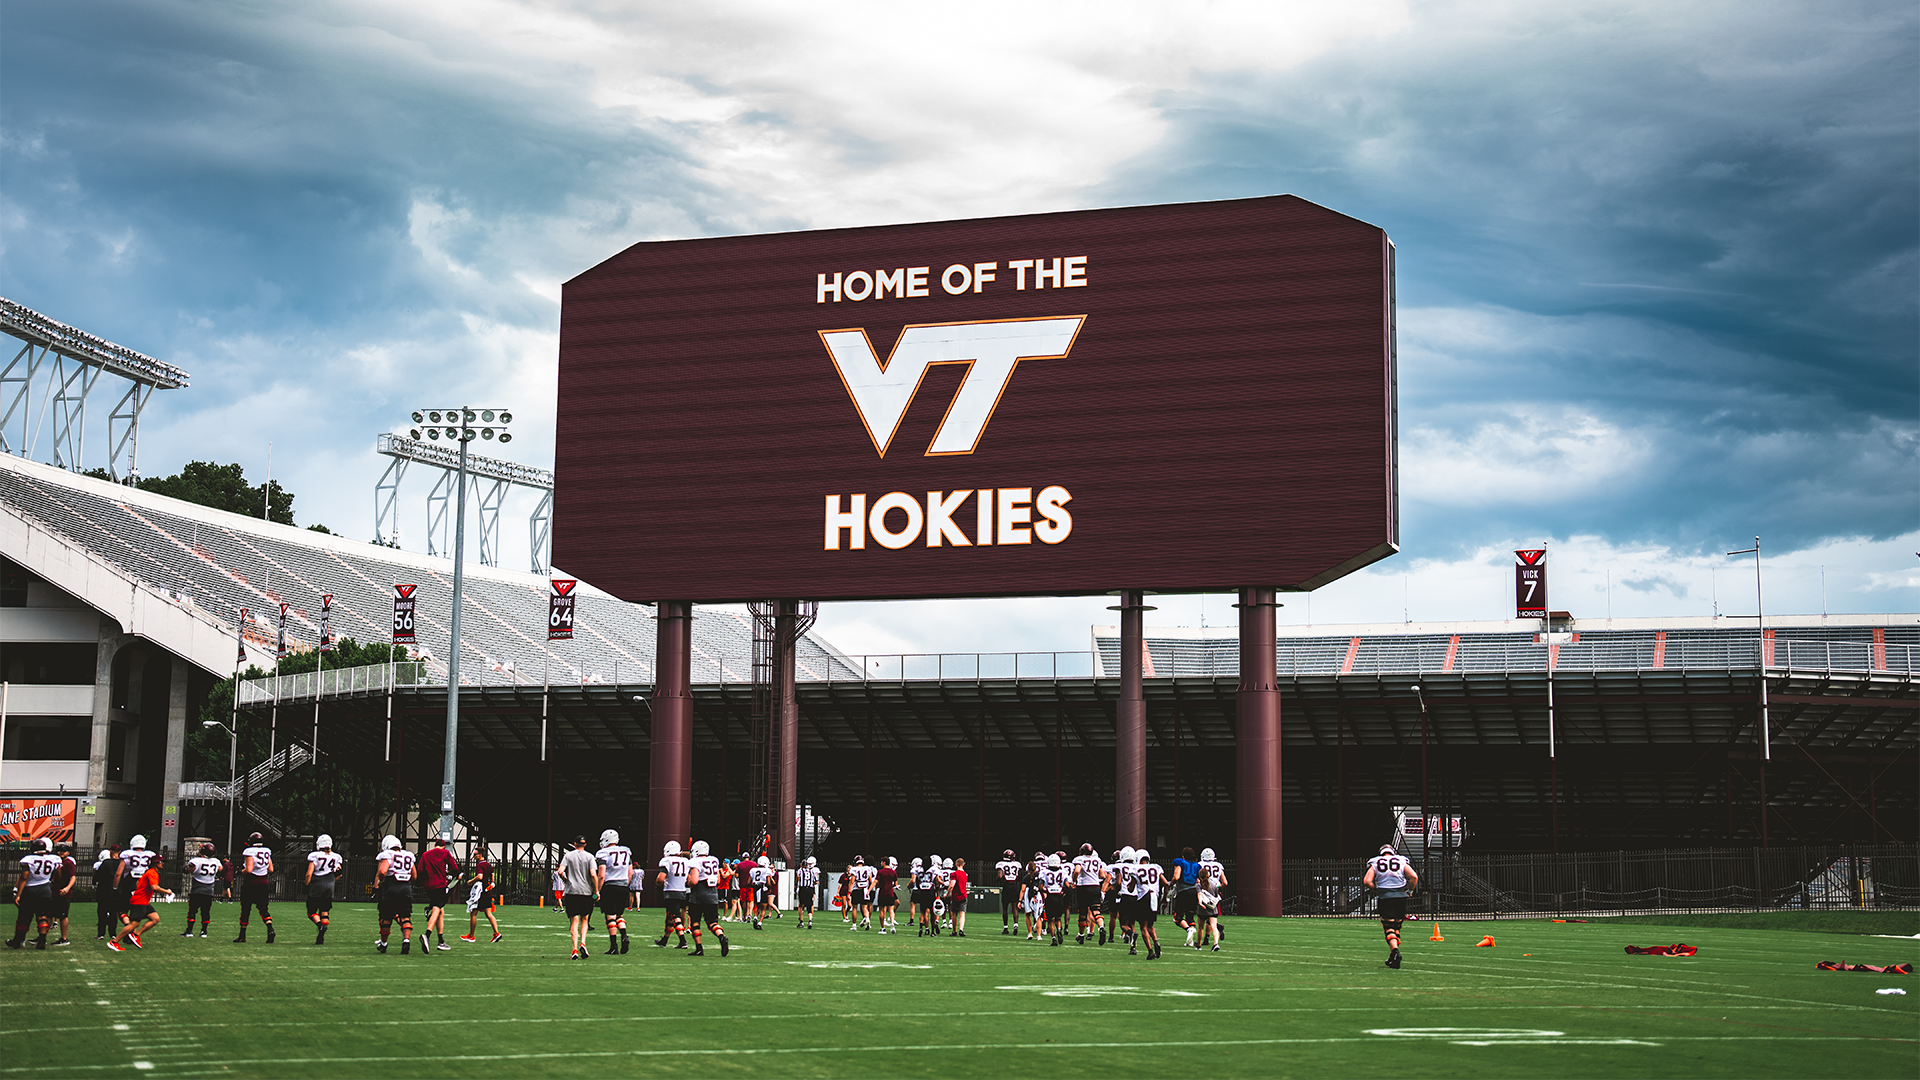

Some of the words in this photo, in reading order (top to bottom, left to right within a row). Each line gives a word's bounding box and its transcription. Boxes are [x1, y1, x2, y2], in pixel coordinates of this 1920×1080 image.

[817, 266, 930, 303] HOME
[941, 262, 998, 295] OF
[1008, 256, 1088, 290] THE
[817, 314, 1088, 459] VT
[824, 485, 1073, 550] HOKIES
[1523, 570, 1538, 578] VICK
[1524, 581, 1537, 602] 7
[395, 611, 412, 630] 56
[550, 608, 572, 626] 64
[22, 804, 61, 822] STADIUM
[130, 856, 149, 868] 63
[257, 852, 270, 866] 59
[318, 858, 336, 872] 74
[394, 855, 412, 871] 58
[610, 851, 628, 866] 77
[1377, 858, 1400, 872] 66
[34, 860, 52, 875] 76
[200, 864, 216, 876] 53
[672, 862, 686, 876] 71
[702, 861, 718, 876] 52
[1003, 866, 1018, 876] 83
[1084, 860, 1099, 874] 79
[755, 870, 762, 882] 2
[857, 870, 868, 880] 14
[1046, 872, 1062, 886] 34
[1138, 868, 1158, 884] 28
